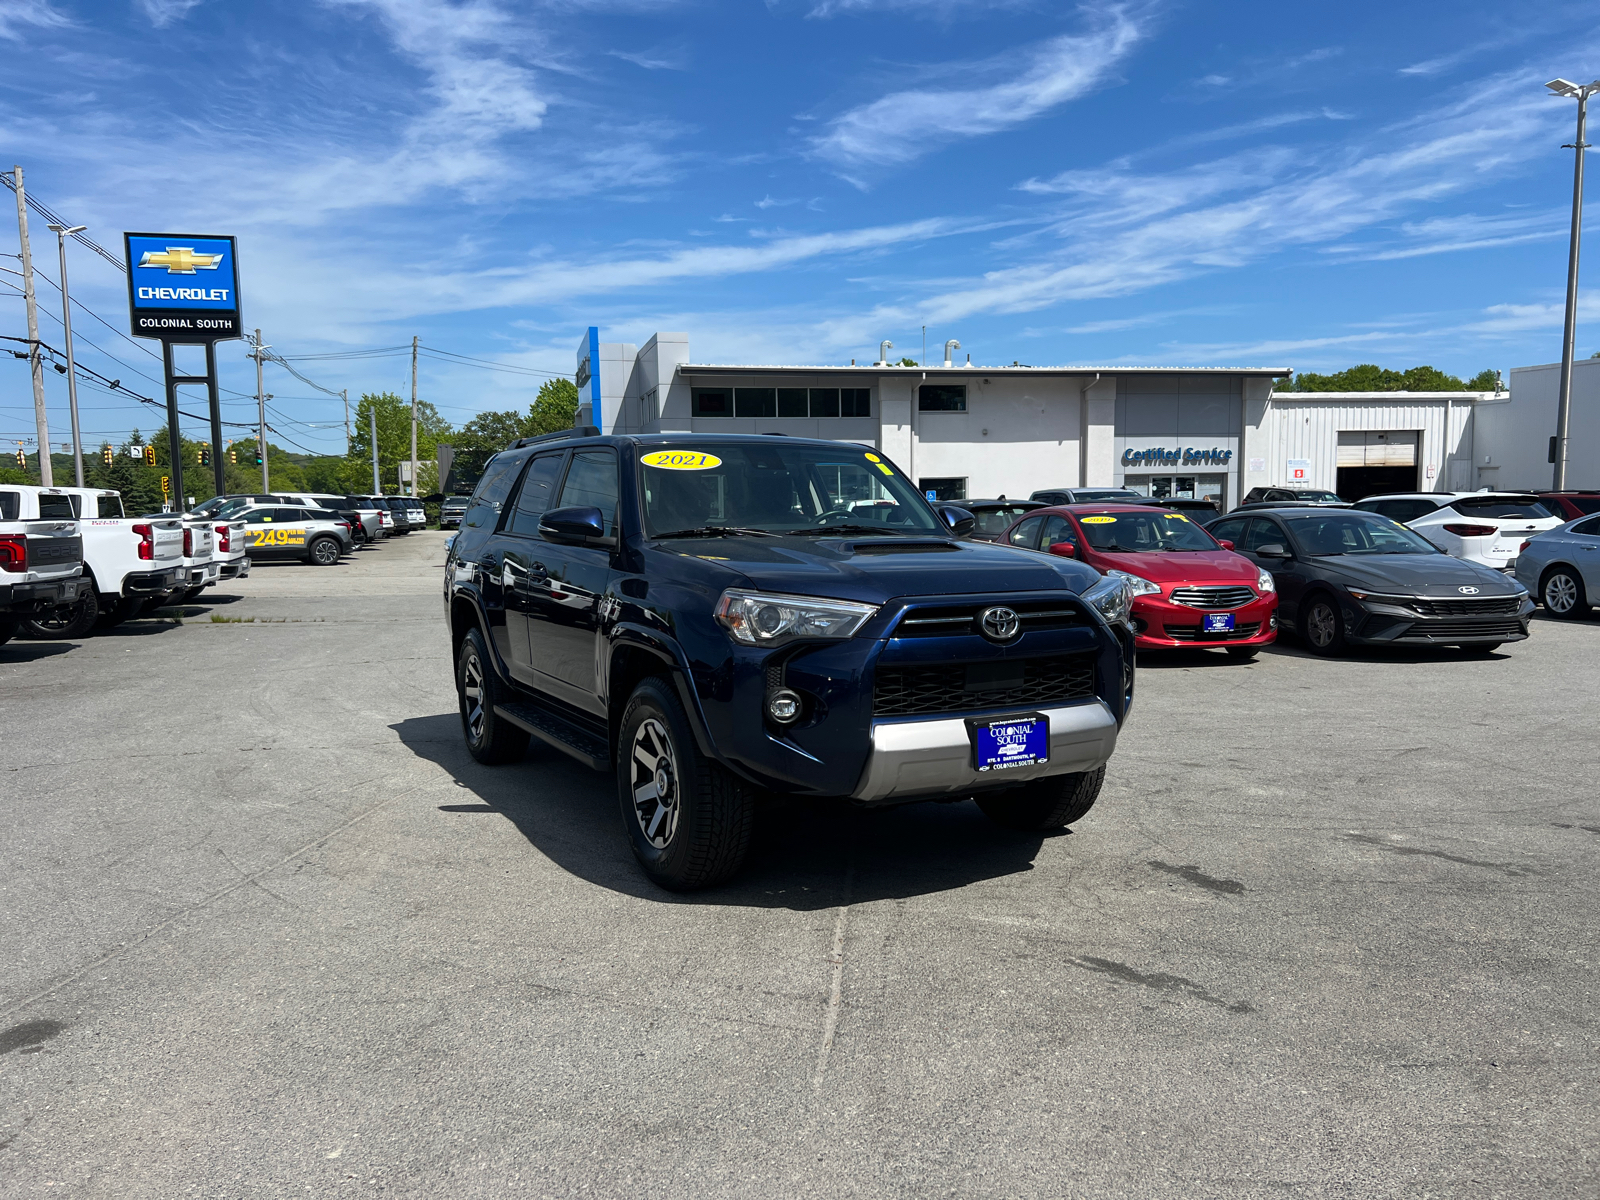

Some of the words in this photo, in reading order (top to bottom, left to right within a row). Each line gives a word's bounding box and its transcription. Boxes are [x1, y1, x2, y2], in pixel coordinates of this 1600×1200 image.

[138, 287, 229, 301] CHEVROLET
[140, 318, 193, 328] COLONIAL
[196, 319, 232, 329] SOUTH
[1124, 447, 1182, 461] Certified
[1185, 446, 1233, 461] Service
[656, 454, 707, 466] 2021
[37, 545, 80, 557] FORD
[990, 725, 1033, 737] COLONIAL
[997, 734, 1027, 745] SOUTH
